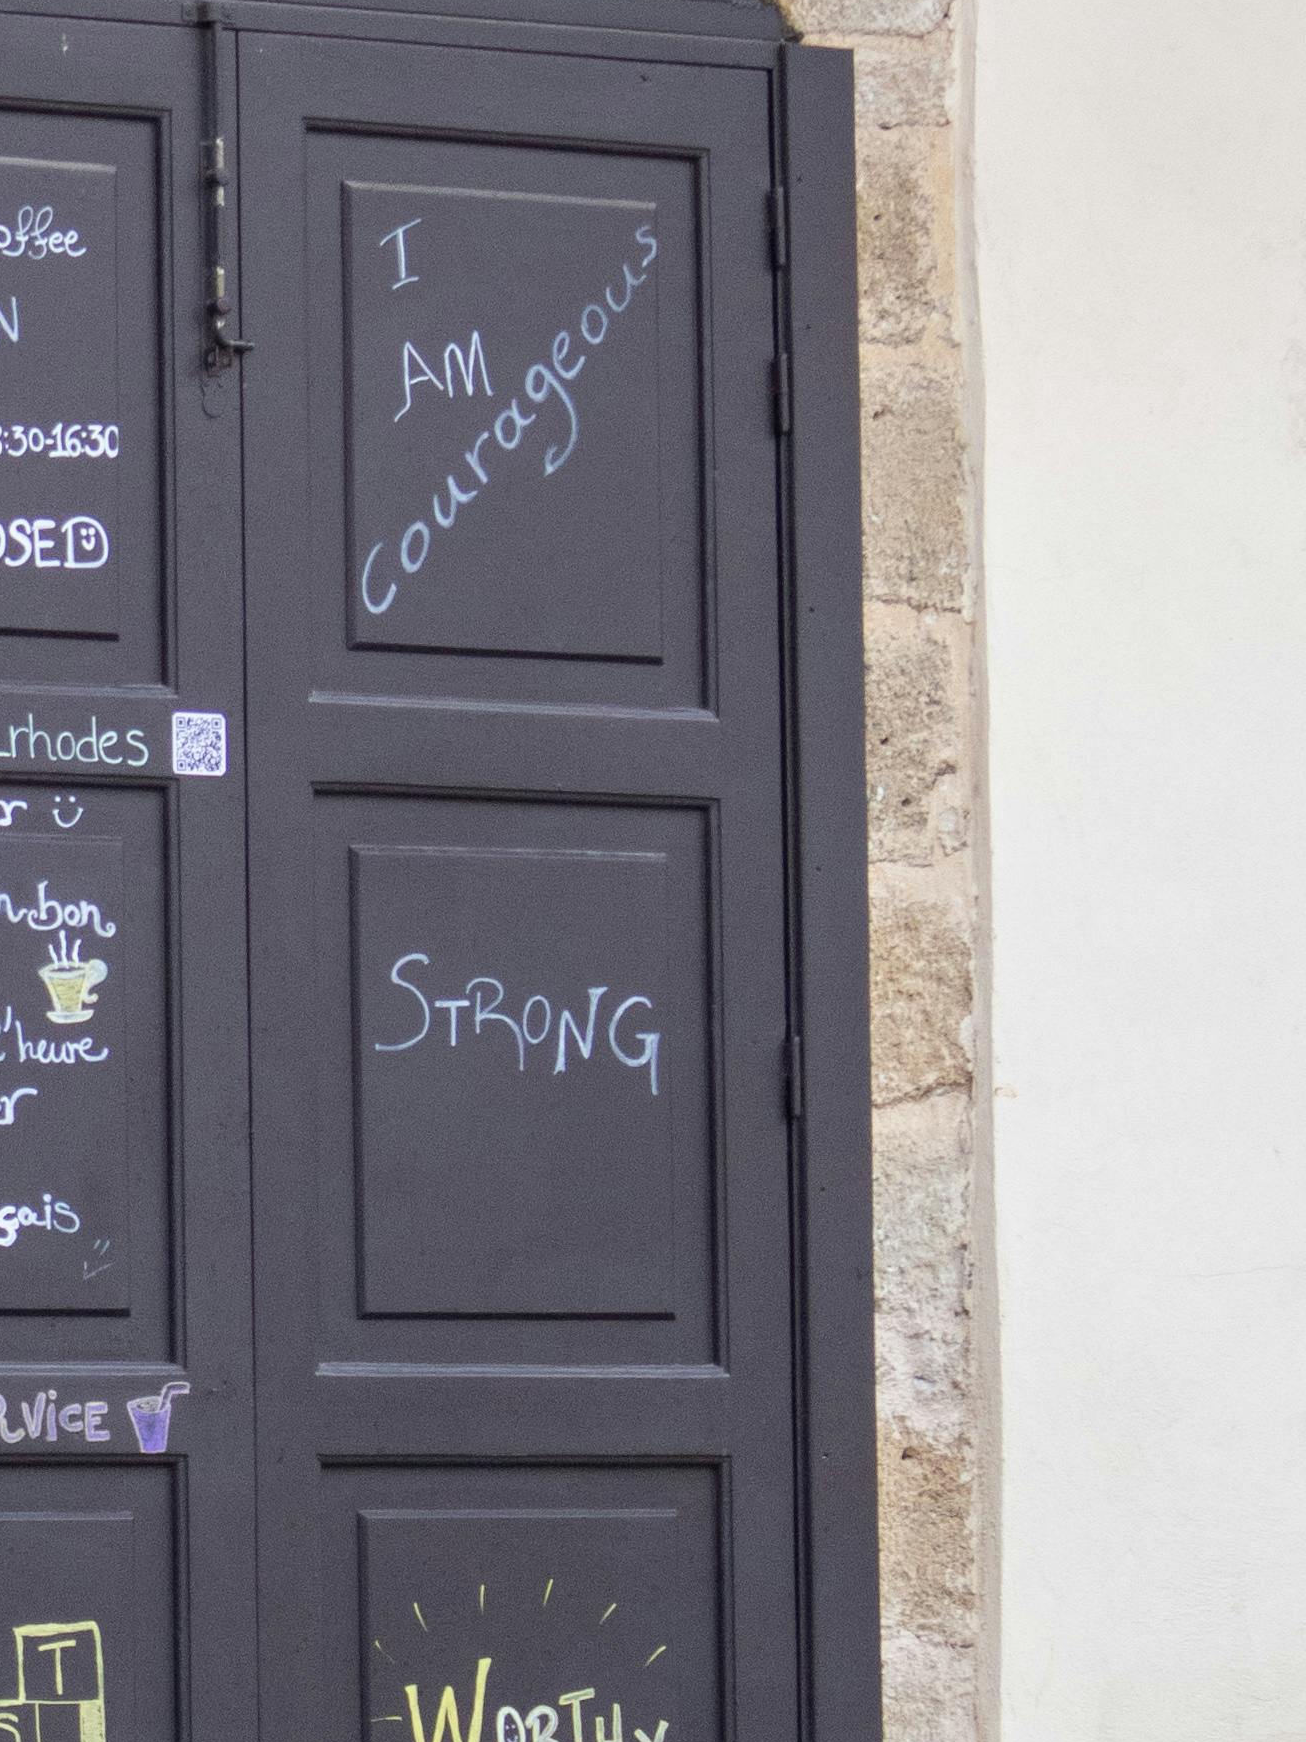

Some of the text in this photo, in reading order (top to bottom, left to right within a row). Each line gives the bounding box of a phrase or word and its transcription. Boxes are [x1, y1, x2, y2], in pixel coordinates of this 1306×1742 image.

[379, 218, 422, 290] I
[393, 329, 494, 423] AM
[375, 952, 660, 1096] STRONG
